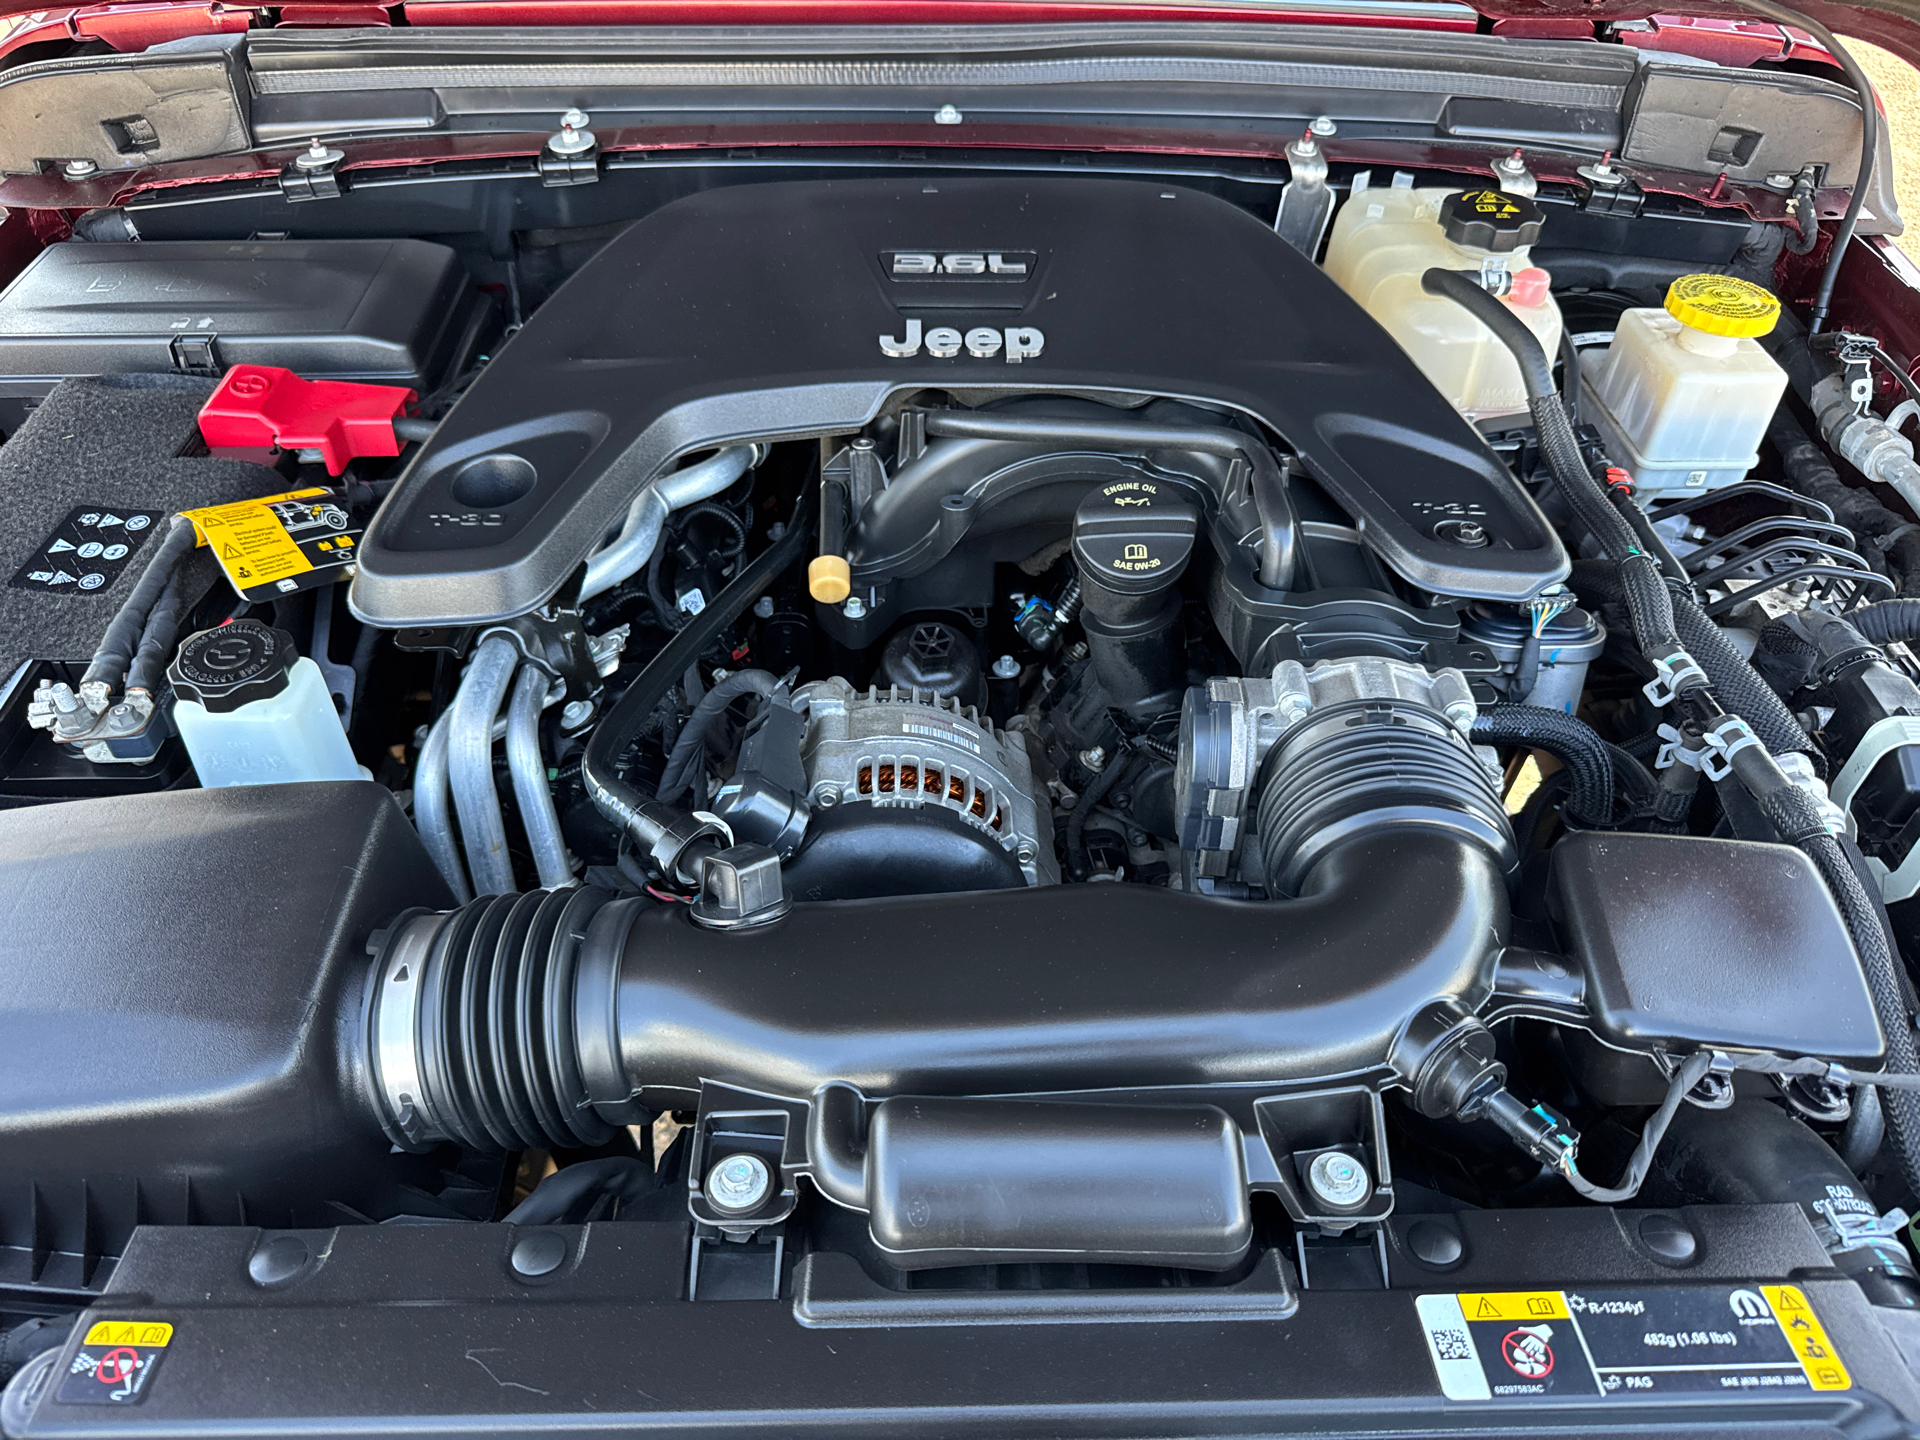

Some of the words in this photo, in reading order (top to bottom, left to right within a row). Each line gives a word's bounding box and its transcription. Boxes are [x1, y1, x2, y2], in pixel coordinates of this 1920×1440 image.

[893, 253, 1027, 274] 3.6L
[879, 319, 1045, 364] Jeep
[1103, 482, 1140, 496] ENGINE
[1141, 484, 1157, 494] OIL
[1113, 559, 1133, 571] SAE
[1134, 558, 1161, 571] 0W-20
[1825, 1185, 1854, 1198] RAD
[1588, 1301, 1645, 1316] R-1234yf
[1643, 1333, 1677, 1347] 482g
[1624, 1376, 1654, 1388] PAG
